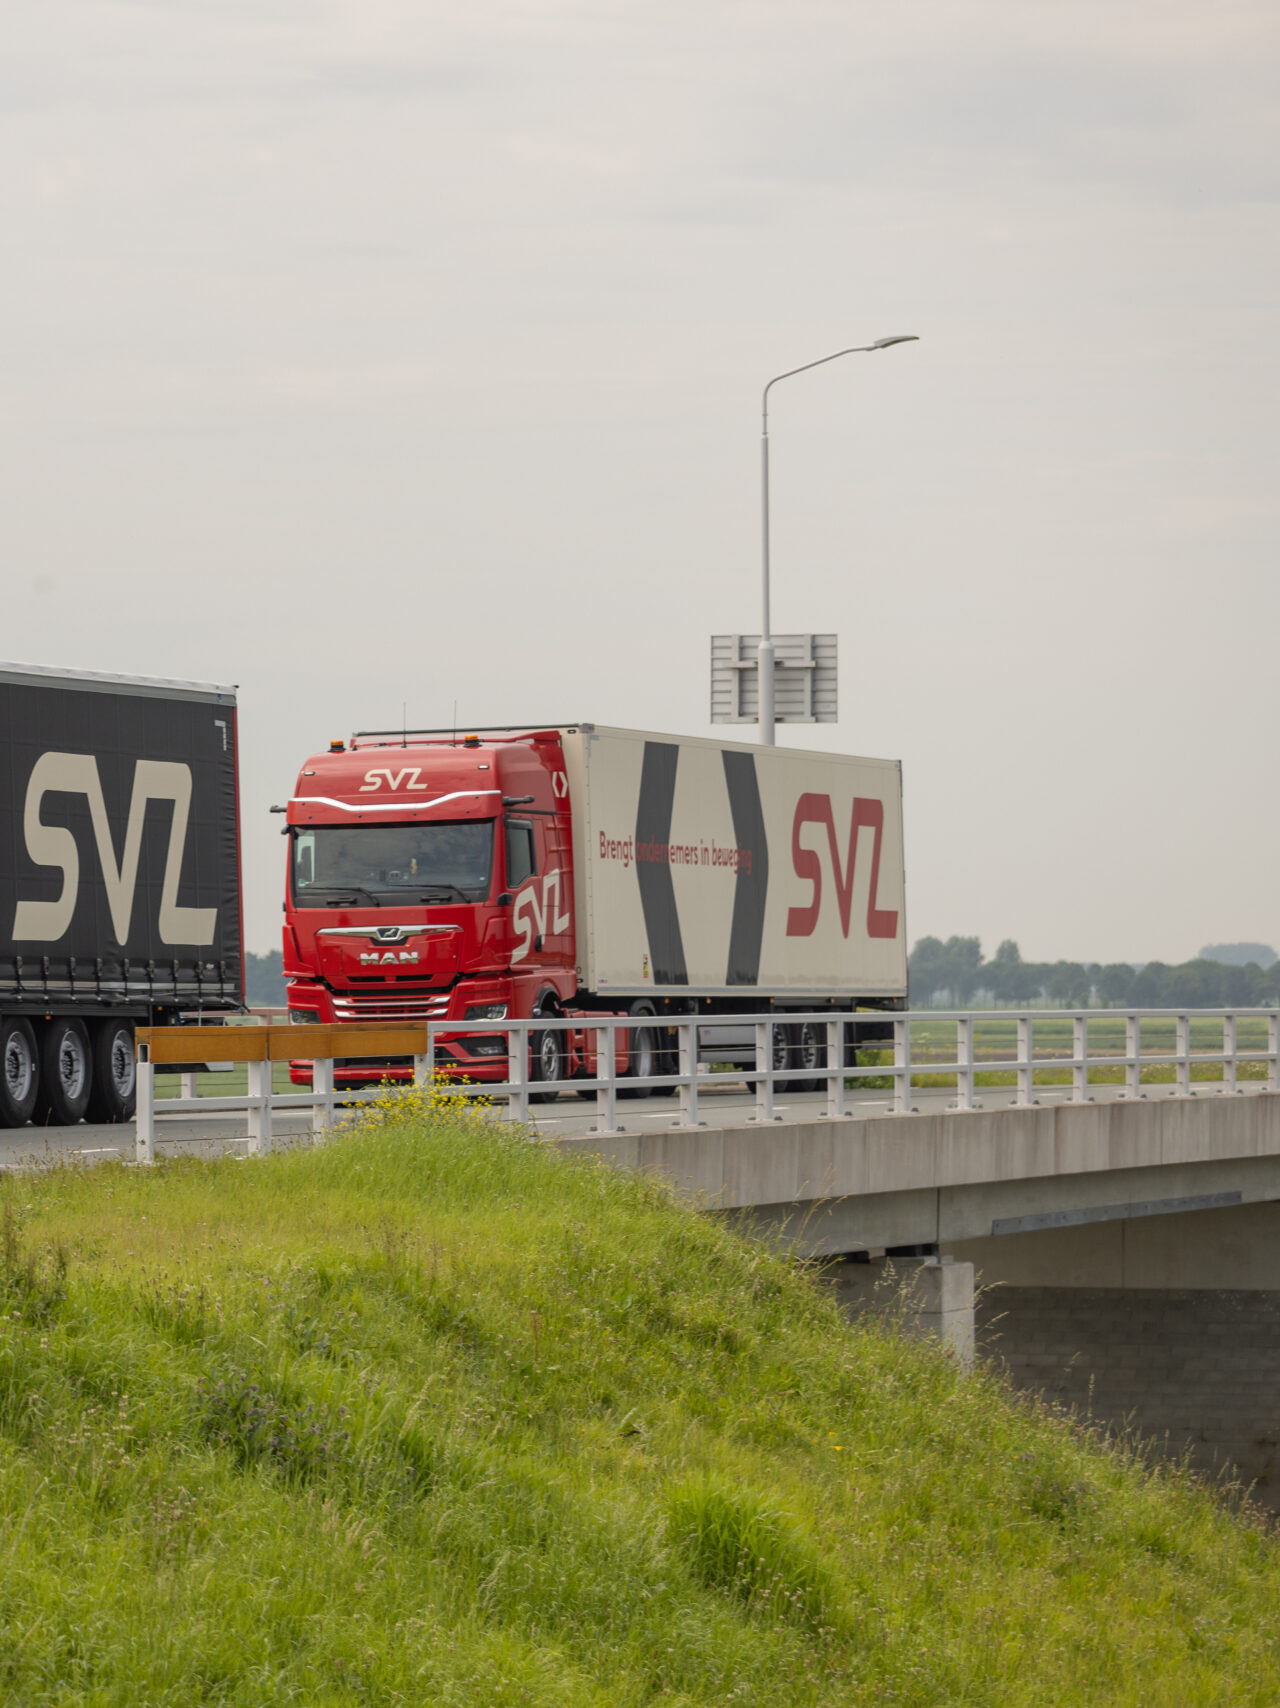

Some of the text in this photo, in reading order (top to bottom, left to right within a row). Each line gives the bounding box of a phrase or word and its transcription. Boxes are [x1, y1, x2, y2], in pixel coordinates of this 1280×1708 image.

[358, 767, 428, 792] SVZ
[11, 751, 218, 946] SVZ
[599, 830, 753, 876] Brengt ondernemers in beweging
[785, 792, 899, 940] SVZ
[511, 868, 570, 965] SVZ
[360, 951, 419, 965] MAN
